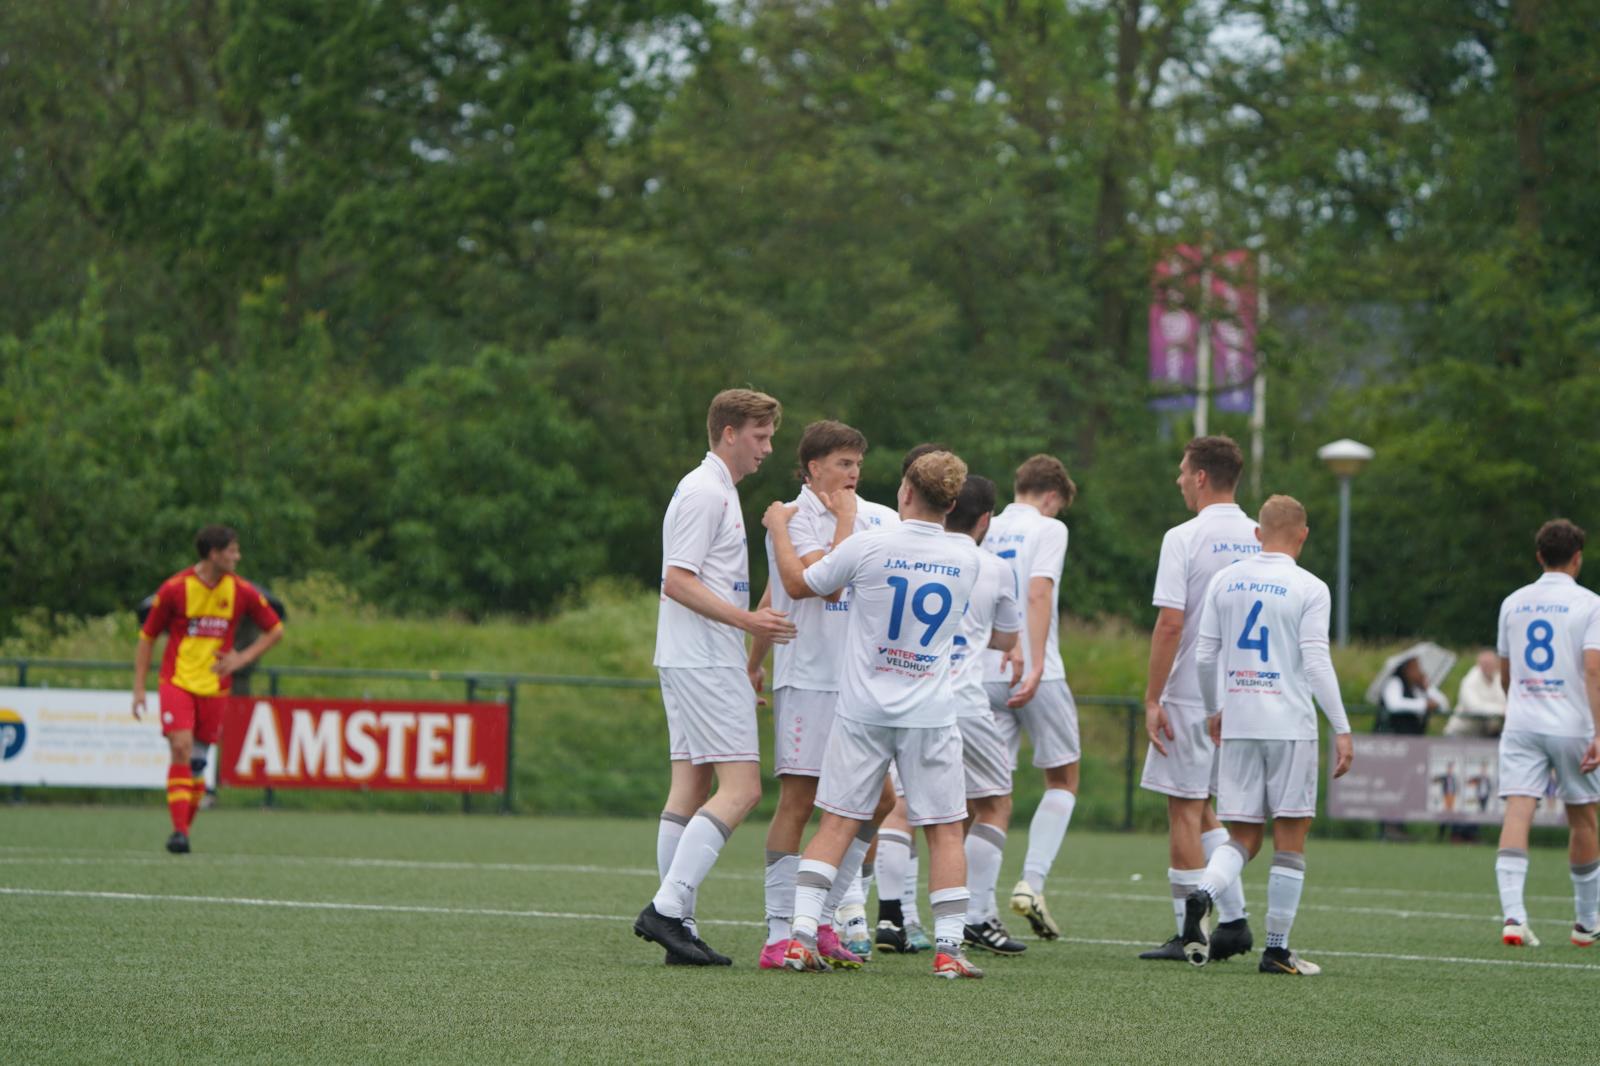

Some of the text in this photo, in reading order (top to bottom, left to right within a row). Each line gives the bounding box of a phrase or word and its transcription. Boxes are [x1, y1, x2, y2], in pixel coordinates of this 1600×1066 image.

[1233, 543, 1264, 553] PUTTE
[883, 558, 961, 578] J.M. PUTTER
[1227, 582, 1288, 597] J.M. PUTTER
[886, 575, 952, 648] 19
[1535, 604, 1570, 614] PUTTER
[1237, 599, 1269, 663] 4
[887, 648, 939, 662] INTERSPOR
[1524, 618, 1555, 672] 8
[235, 701, 486, 782] AMSTEL
